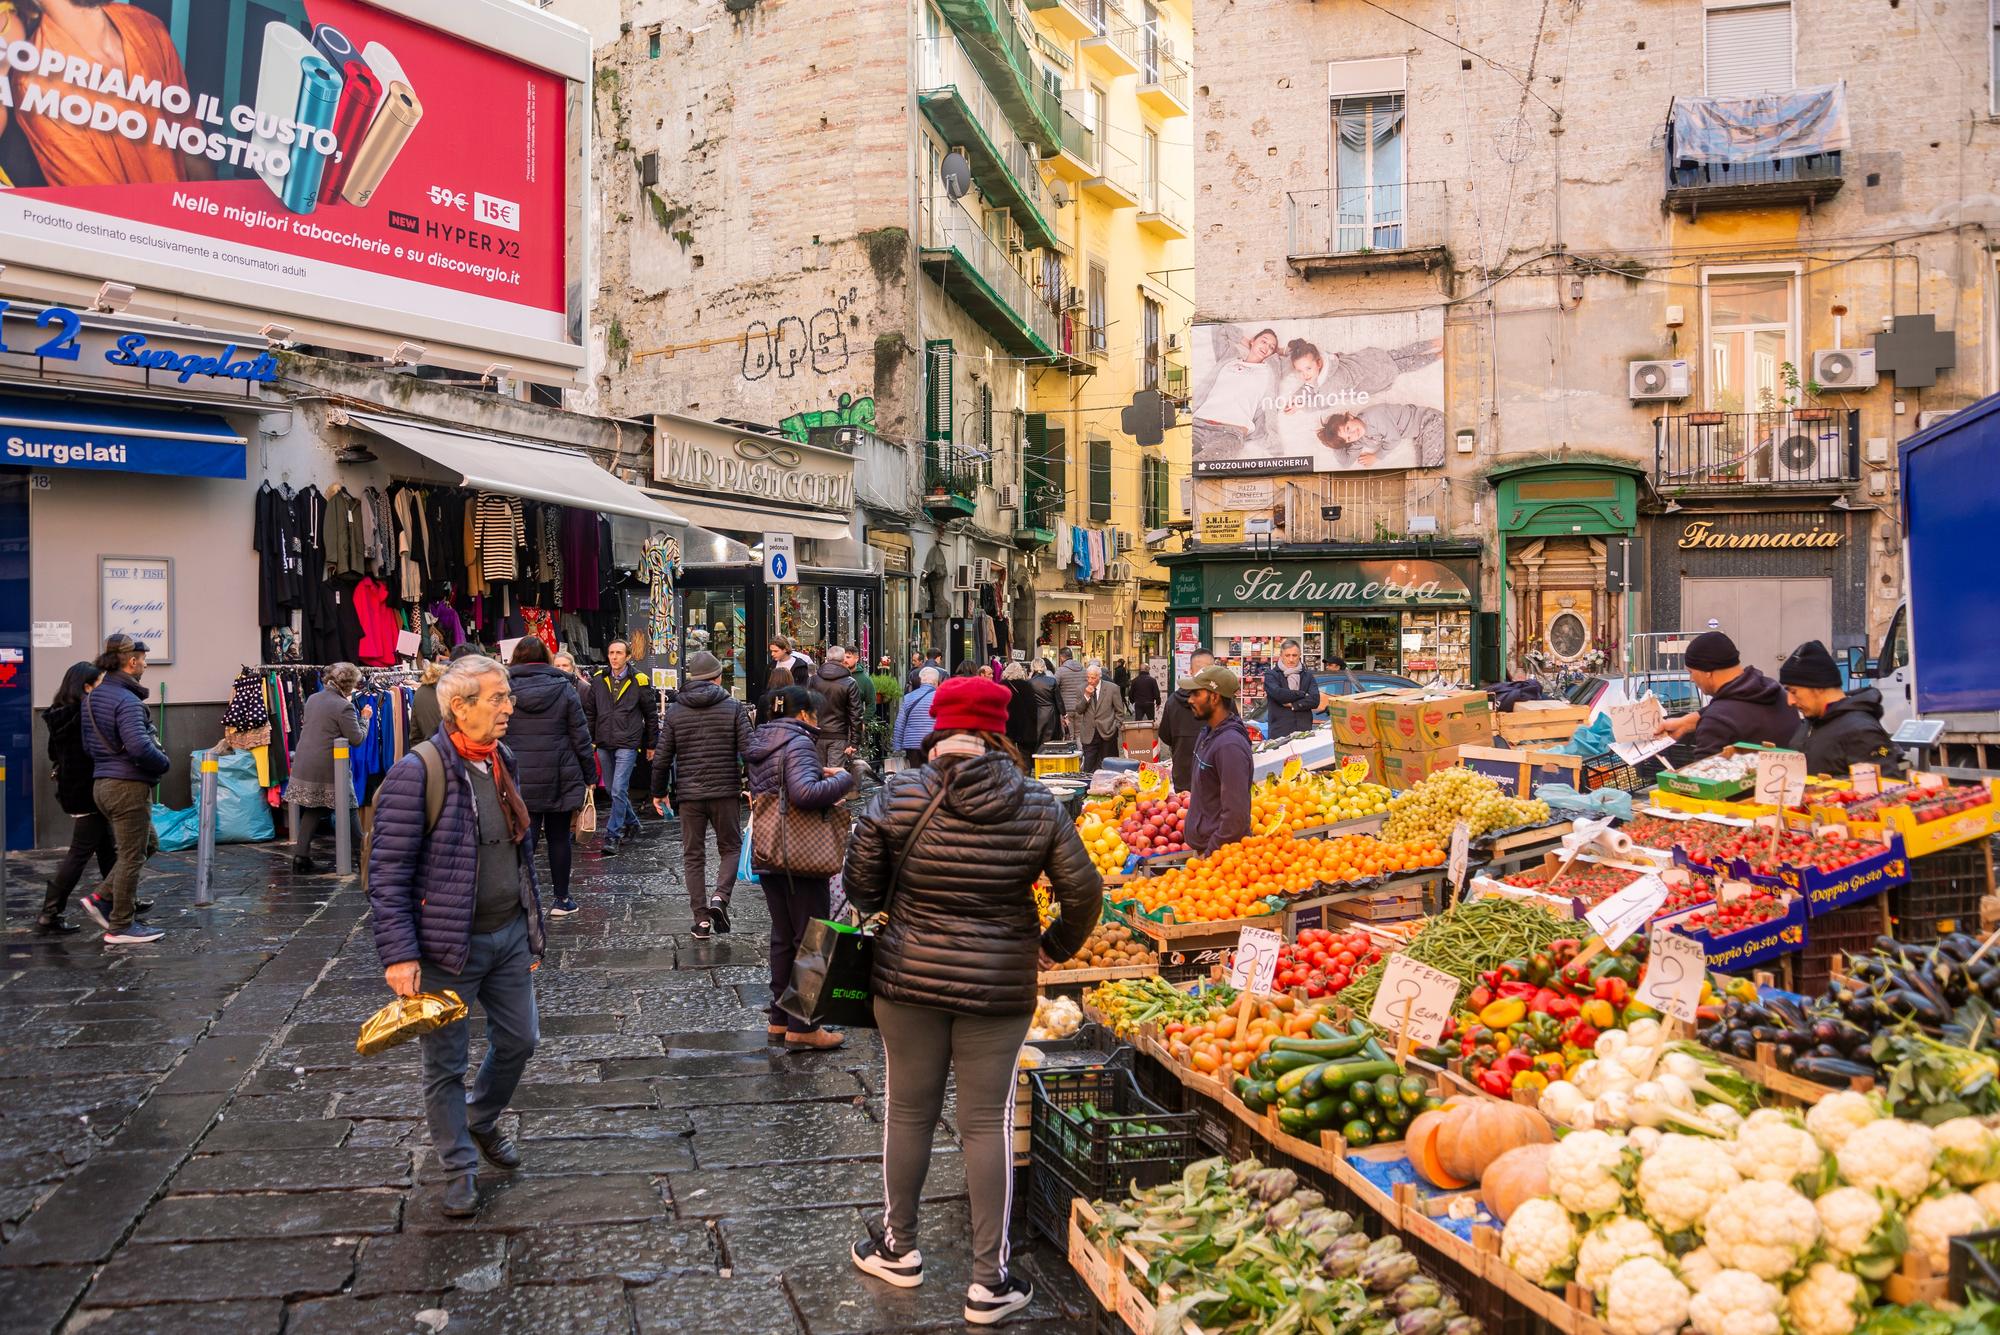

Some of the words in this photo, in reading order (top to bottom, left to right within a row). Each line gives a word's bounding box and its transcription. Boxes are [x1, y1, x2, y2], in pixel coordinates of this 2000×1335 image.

[0, 36, 190, 114] OPRIAMO
[195, 93, 224, 125] IL
[230, 105, 343, 163] GUSTO,
[20, 83, 147, 139] MODO
[152, 118, 290, 176] NOSTRO
[426, 185, 469, 211] 59€
[23, 209, 73, 230] Prodotto
[76, 220, 126, 241] destinato
[129, 232, 210, 258] esclusivamente
[212, 251, 218, 259] a
[221, 252, 280, 272] consumatori
[282, 264, 307, 277] adulti
[172, 191, 219, 215] Nelle
[223, 206, 289, 231] migliori
[292, 222, 390, 255] tabaccherie
[394, 246, 404, 258] e
[407, 249, 424, 262] su
[427, 252, 520, 285] discoverglo.it
[391, 215, 417, 229] NEW
[426, 220, 491, 252] HYPER
[498, 238, 520, 259] X2
[36, 307, 81, 361] 2
[105, 334, 281, 384] Surgelati
[1262, 388, 1369, 410] noidinotte
[7, 437, 127, 464] Surgelati
[661, 433, 716, 488] BAR
[1209, 461, 1257, 470] COZZOLINO
[1258, 459, 1309, 468] BIANCHERIA
[33, 475, 49, 488] 18
[1678, 521, 1845, 548] Farmacia
[111, 569, 128, 577] TOP
[144, 569, 163, 579] FISH
[1234, 567, 1444, 602] Salumeria
[1763, 764, 1791, 794] 2
[1811, 880, 1849, 904] Doppio
[1851, 868, 1882, 892] Gusto
[1242, 927, 1281, 943] OFFERTA
[1652, 928, 1663, 956] 3
[1664, 935, 1704, 961] TESTE
[1705, 947, 1742, 967] Doppio
[1743, 935, 1778, 956] Gusto
[1650, 955, 1687, 1005] 2
[1385, 979, 1424, 1025] 2
